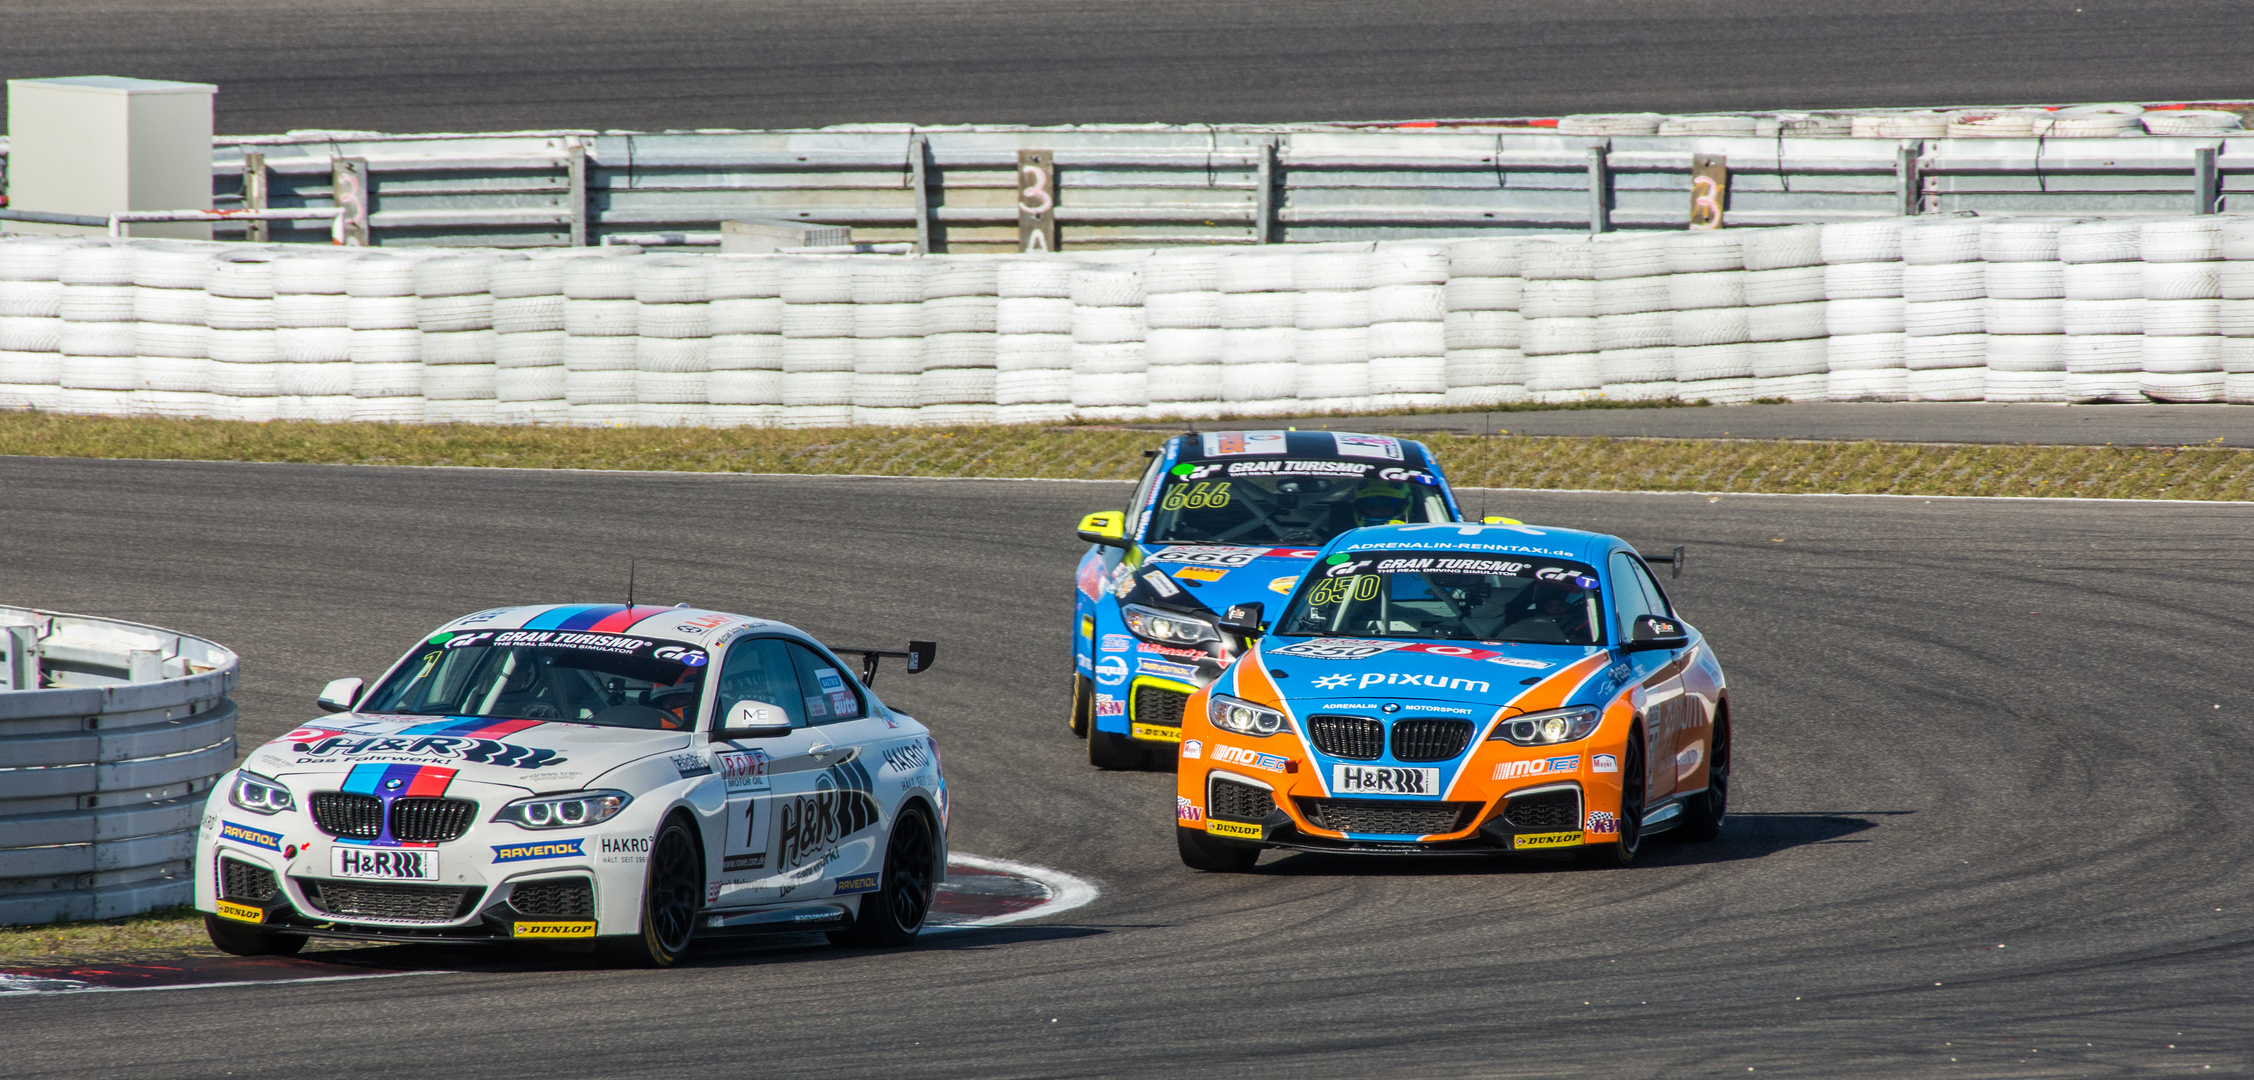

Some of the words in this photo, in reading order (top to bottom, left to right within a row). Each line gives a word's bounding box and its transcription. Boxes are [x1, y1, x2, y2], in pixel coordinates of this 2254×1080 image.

[1019, 166, 1051, 213] 3
[1690, 176, 1720, 230] 3
[1228, 461, 1282, 473] GRAN
[1162, 482, 1231, 510] 666
[1347, 542, 1574, 557] ADRENALIN-RENNTAXI.de
[1157, 552, 1248, 563] 666
[1377, 559, 1435, 569] GRAN
[1463, 569, 1517, 577] SIMULATOR
[1581, 576, 1595, 587] T
[1309, 574, 1381, 606] 650
[494, 632, 555, 642] GRAN
[582, 645, 633, 655] SIMULATOR
[1280, 645, 1382, 656] 650
[419, 650, 443, 677] 1
[690, 654, 704, 665] T
[1358, 673, 1490, 692] pixum
[834, 698, 857, 715] auto
[1405, 705, 1472, 714] MOTORSPORT
[308, 737, 462, 757] H&R
[344, 755, 452, 765] Fahrwerk!
[882, 742, 930, 773] HAKRO
[724, 754, 764, 777] ROWE
[728, 777, 751, 788] MOTOR
[754, 776, 764, 785] OIL
[1344, 766, 1397, 793] H&R
[1178, 805, 1202, 821] KW
[744, 798, 755, 848] 1
[777, 773, 838, 874] H&R
[1217, 824, 1259, 835] DUNLOP
[224, 825, 279, 847] RAVENOL
[1528, 834, 1581, 845] DUNLOP
[500, 843, 578, 859] RAVENOL
[602, 838, 649, 853] HAKRO
[342, 849, 395, 878] H&R
[838, 877, 877, 890] RAVENOL
[224, 906, 260, 919] DUNLOP
[529, 925, 592, 933] DUNLOP
